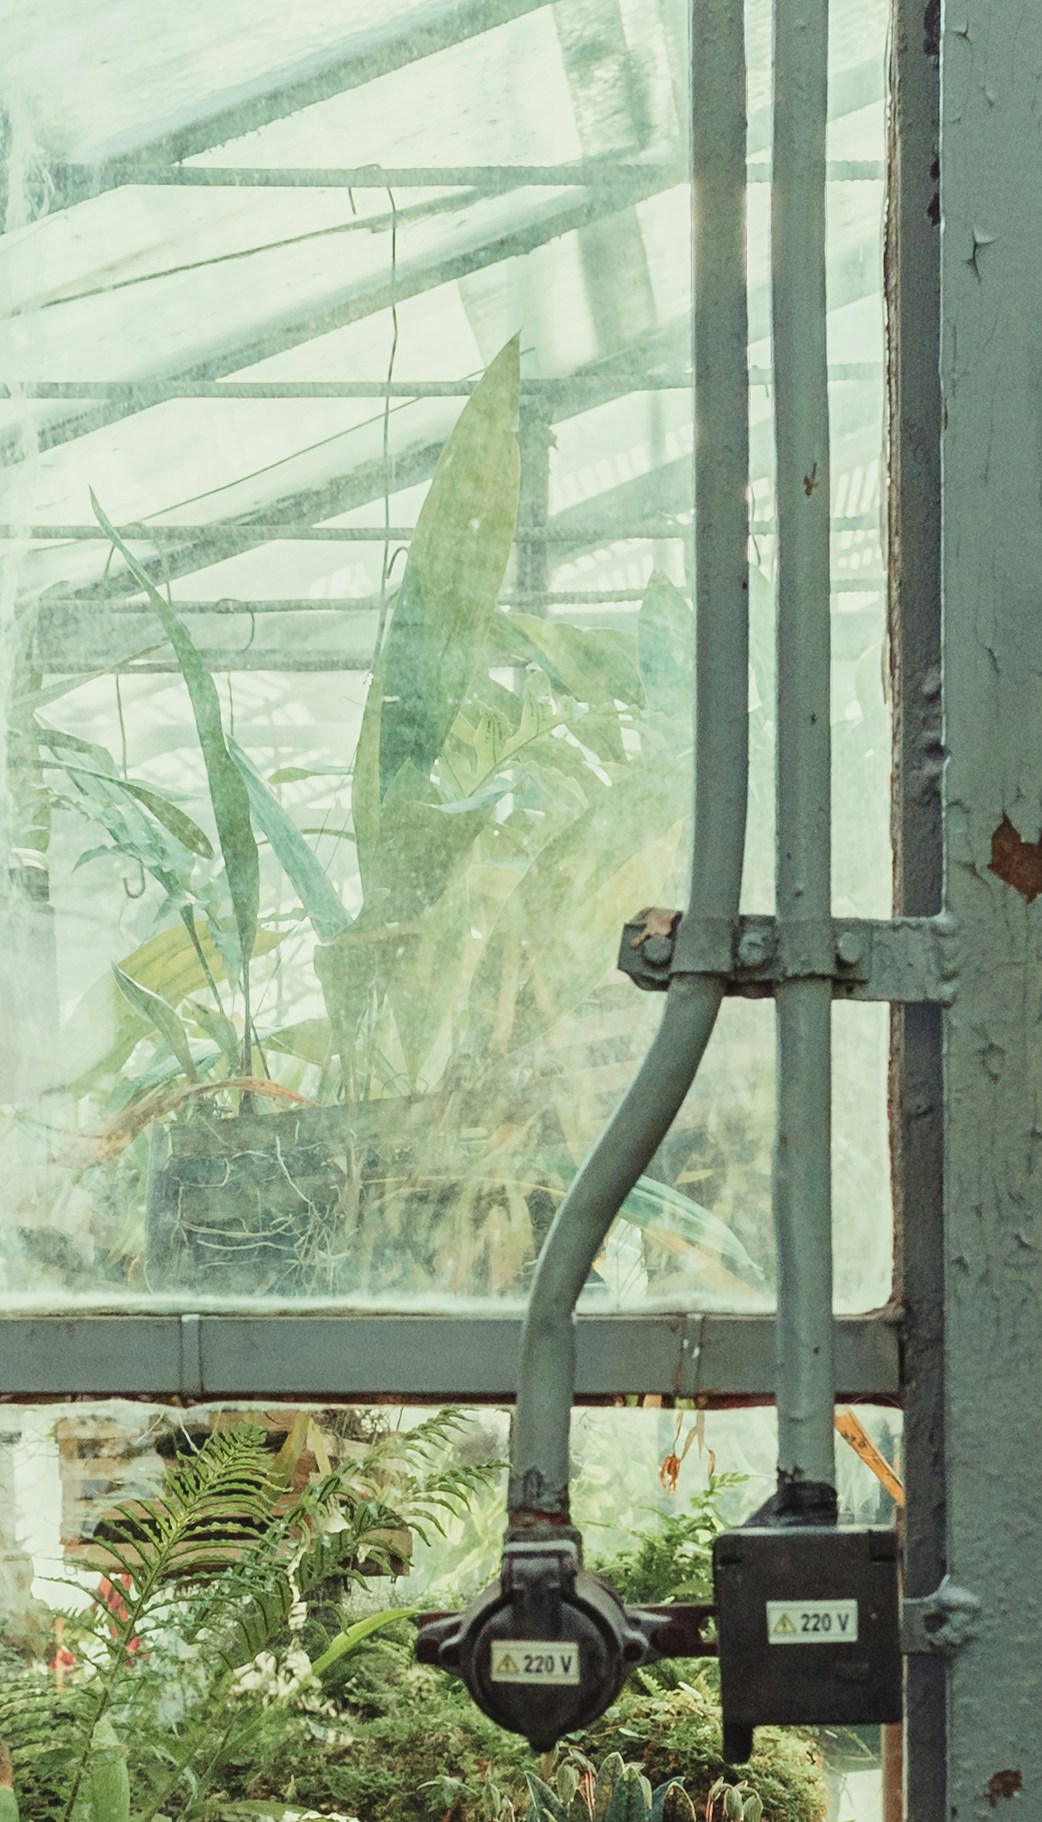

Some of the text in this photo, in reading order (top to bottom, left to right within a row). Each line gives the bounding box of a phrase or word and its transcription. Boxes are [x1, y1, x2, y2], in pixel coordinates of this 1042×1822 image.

[801, 1613, 849, 1632] 220 V
[524, 1654, 572, 1674] 220 V
